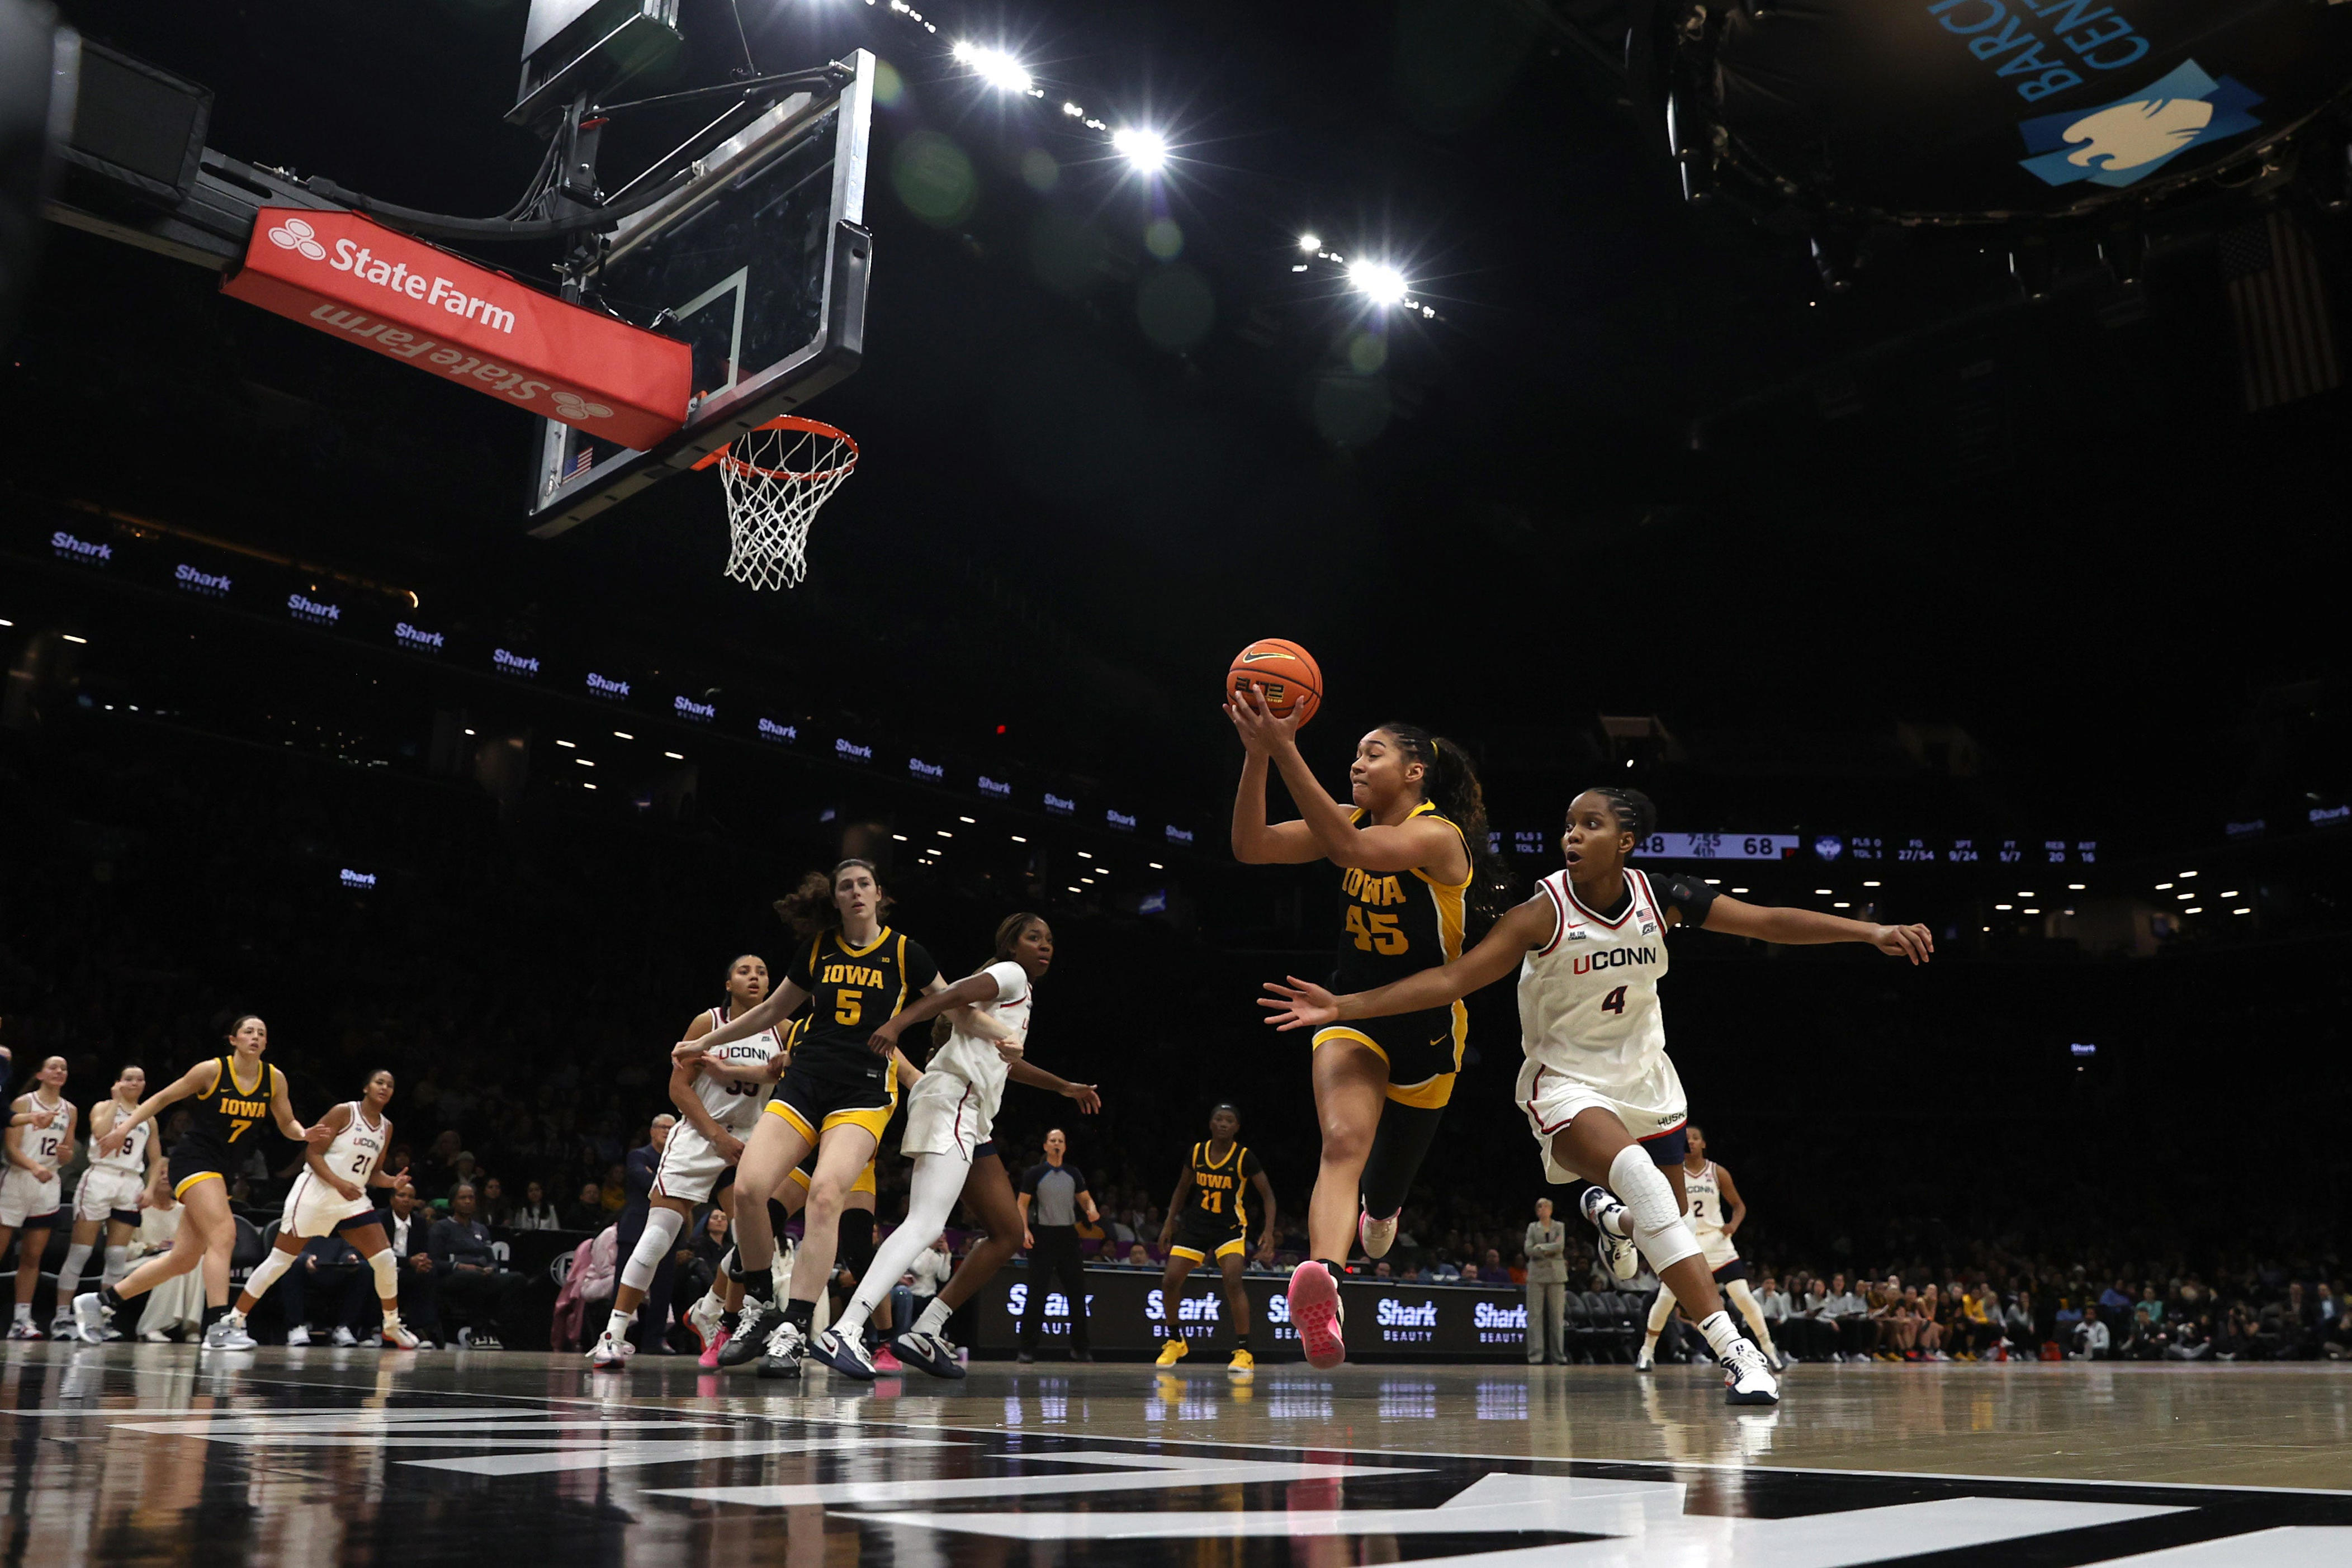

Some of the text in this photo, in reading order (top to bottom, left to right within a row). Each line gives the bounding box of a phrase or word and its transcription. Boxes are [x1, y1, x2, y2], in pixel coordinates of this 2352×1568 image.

[51, 531, 113, 560] Shark
[175, 563, 233, 591] Shark
[287, 594, 341, 620] Shark
[395, 622, 444, 648] Shark
[493, 648, 540, 672] Shark
[586, 672, 631, 696] Shark
[674, 695, 716, 718] Shark
[758, 717, 798, 740] Shark
[836, 738, 872, 759] Shark
[909, 757, 944, 778] Shark
[978, 775, 1011, 794] Shark
[1044, 793, 1075, 811] Shark
[1635, 836, 1664, 854] 48
[1744, 837, 1772, 855] 68
[1342, 867, 1406, 906] IOWA
[1345, 904, 1409, 955] 45
[1574, 947, 1656, 974] UCONN
[821, 964, 884, 989] IOWA
[835, 988, 863, 1026] 5
[1602, 986, 1628, 1015] 4
[719, 1045, 770, 1062] UCONN
[219, 1097, 266, 1117] IOWA
[228, 1119, 252, 1143] 7
[41, 1137, 58, 1155] 12
[352, 1154, 372, 1175] 21
[1196, 1172, 1232, 1190] IOWA
[1200, 1190, 1222, 1214] 11
[1693, 1200, 1704, 1218] 2
[1376, 1298, 1438, 1327] Shark
[1474, 1302, 1528, 1329] Shark
[1384, 1330, 1433, 1342] BEAUTY
[1480, 1332, 1525, 1343] BEAUTY
